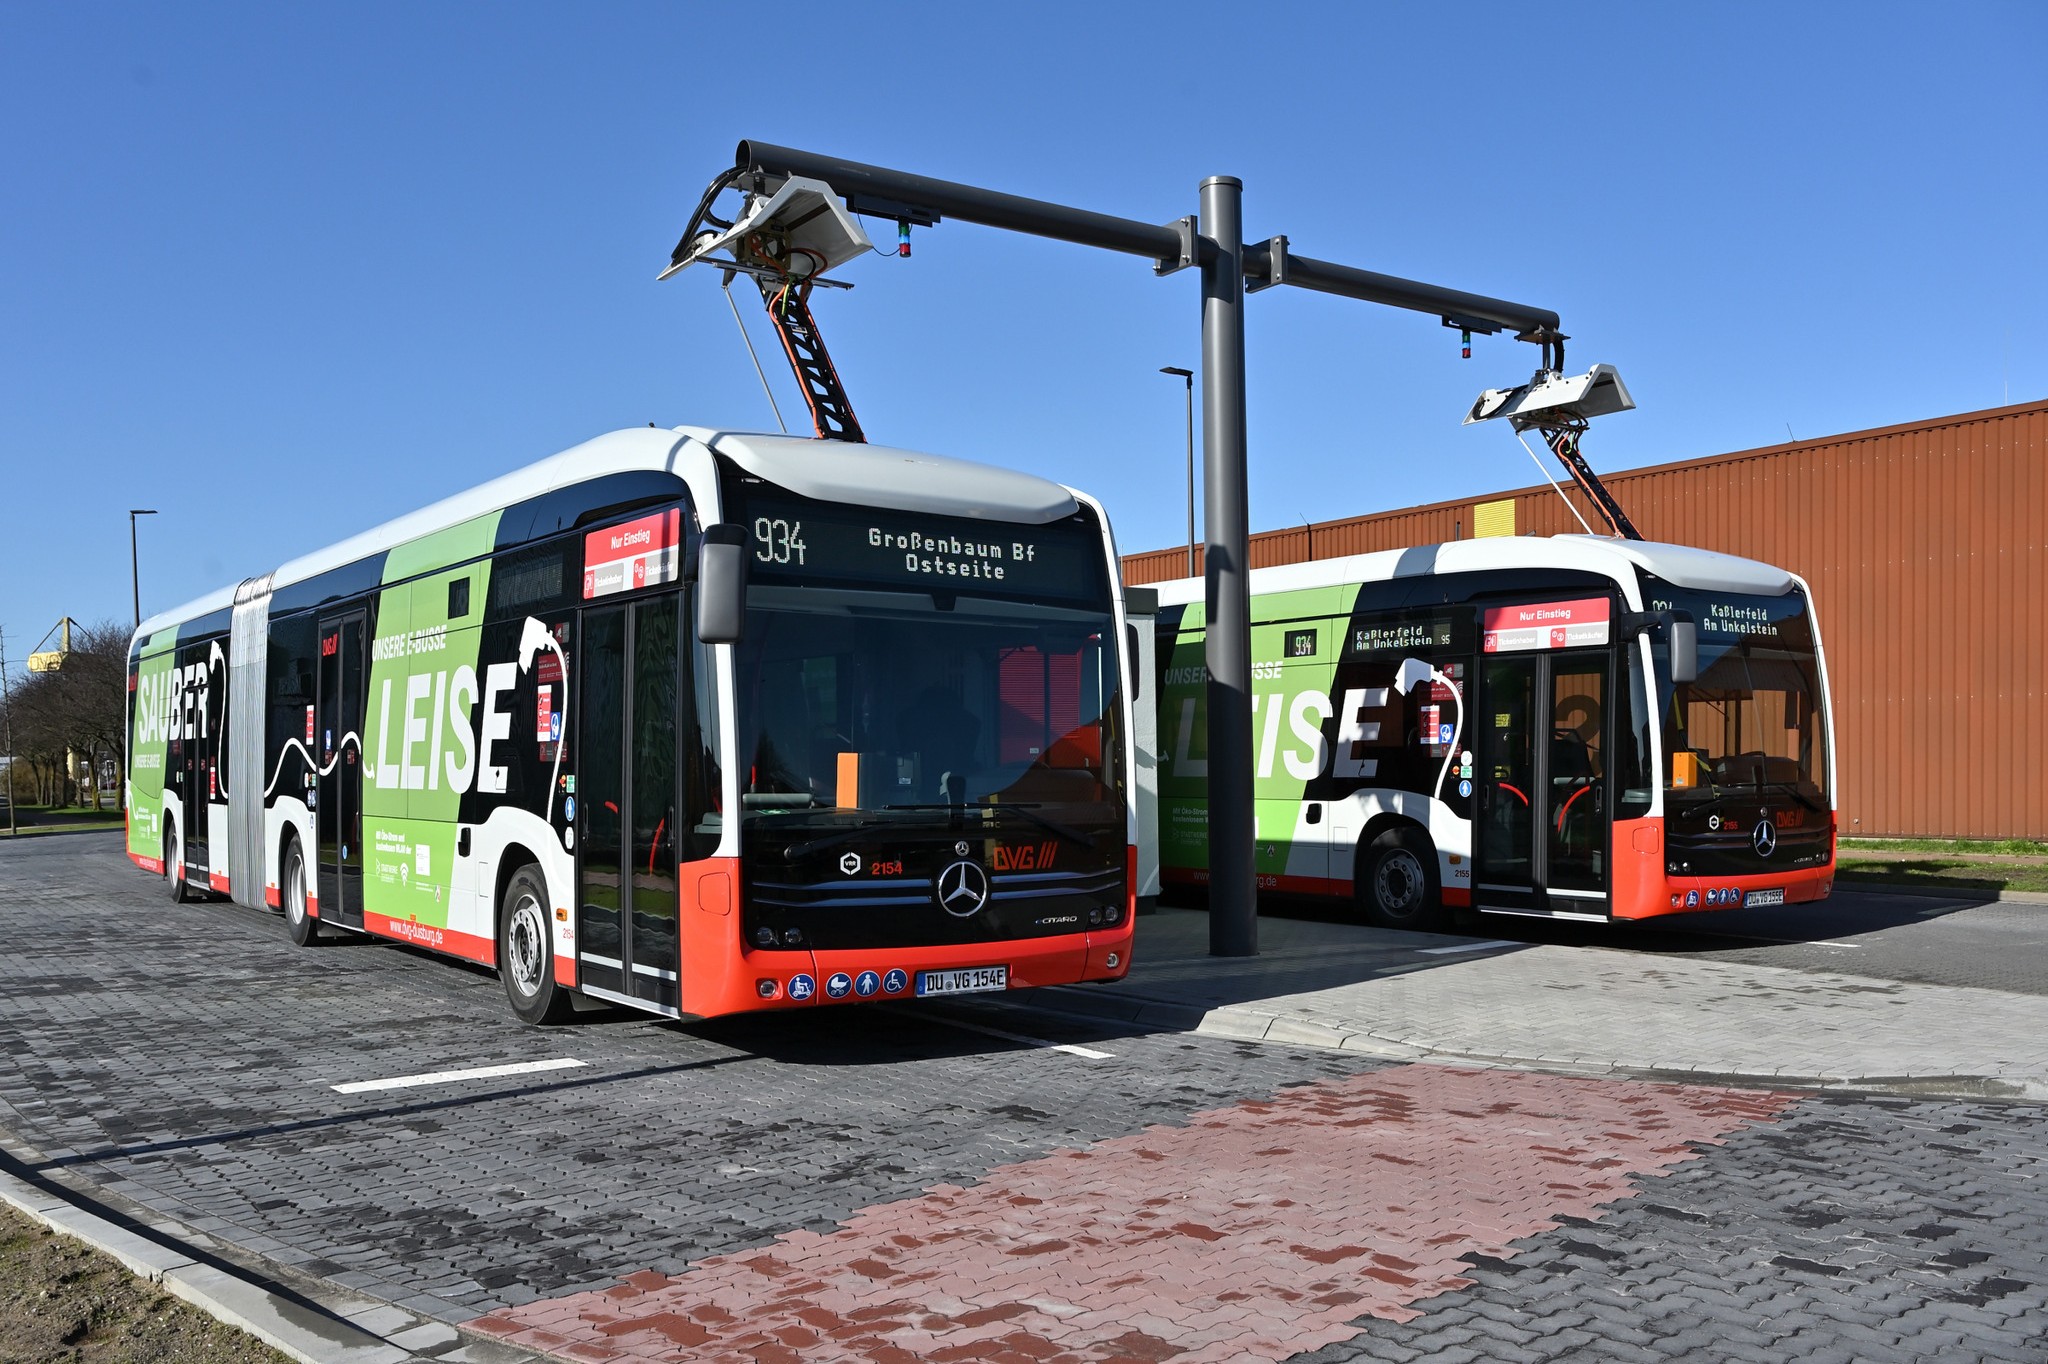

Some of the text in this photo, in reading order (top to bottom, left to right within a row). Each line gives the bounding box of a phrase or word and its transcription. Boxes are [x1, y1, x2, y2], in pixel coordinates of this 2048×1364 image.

[610, 529, 651, 550] Nur Einstieg
[755, 517, 1035, 566] 934 Großenbaum Bf
[905, 553, 1005, 580] Ostseite
[1519, 608, 1571, 621] Nur Einstieg
[1710, 604, 1768, 621] Kaßlerfeld
[1356, 625, 1423, 641] Kaßlerfeld
[1703, 618, 1778, 636] Am Unkelstein
[372, 624, 448, 662] UNSERE E-BUSSE
[1295, 635, 1312, 656] 934
[1356, 641, 1370, 651] Am
[1373, 636, 1433, 650] Unkelstein
[1163, 666, 1208, 685] UNSER
[138, 661, 209, 745] SAUBER
[376, 661, 518, 794] LEISE
[1172, 687, 1389, 781] LISE
[1723, 821, 1739, 830] 2155
[871, 861, 903, 875] 2154
[1454, 869, 1470, 878] 2155
[1748, 893, 1757, 905] DU
[1759, 892, 1768, 903] VG
[389, 919, 443, 947] www.dvg-duisburg.de
[562, 928, 574, 940] 2154
[926, 969, 1004, 992] DU VG 154E
